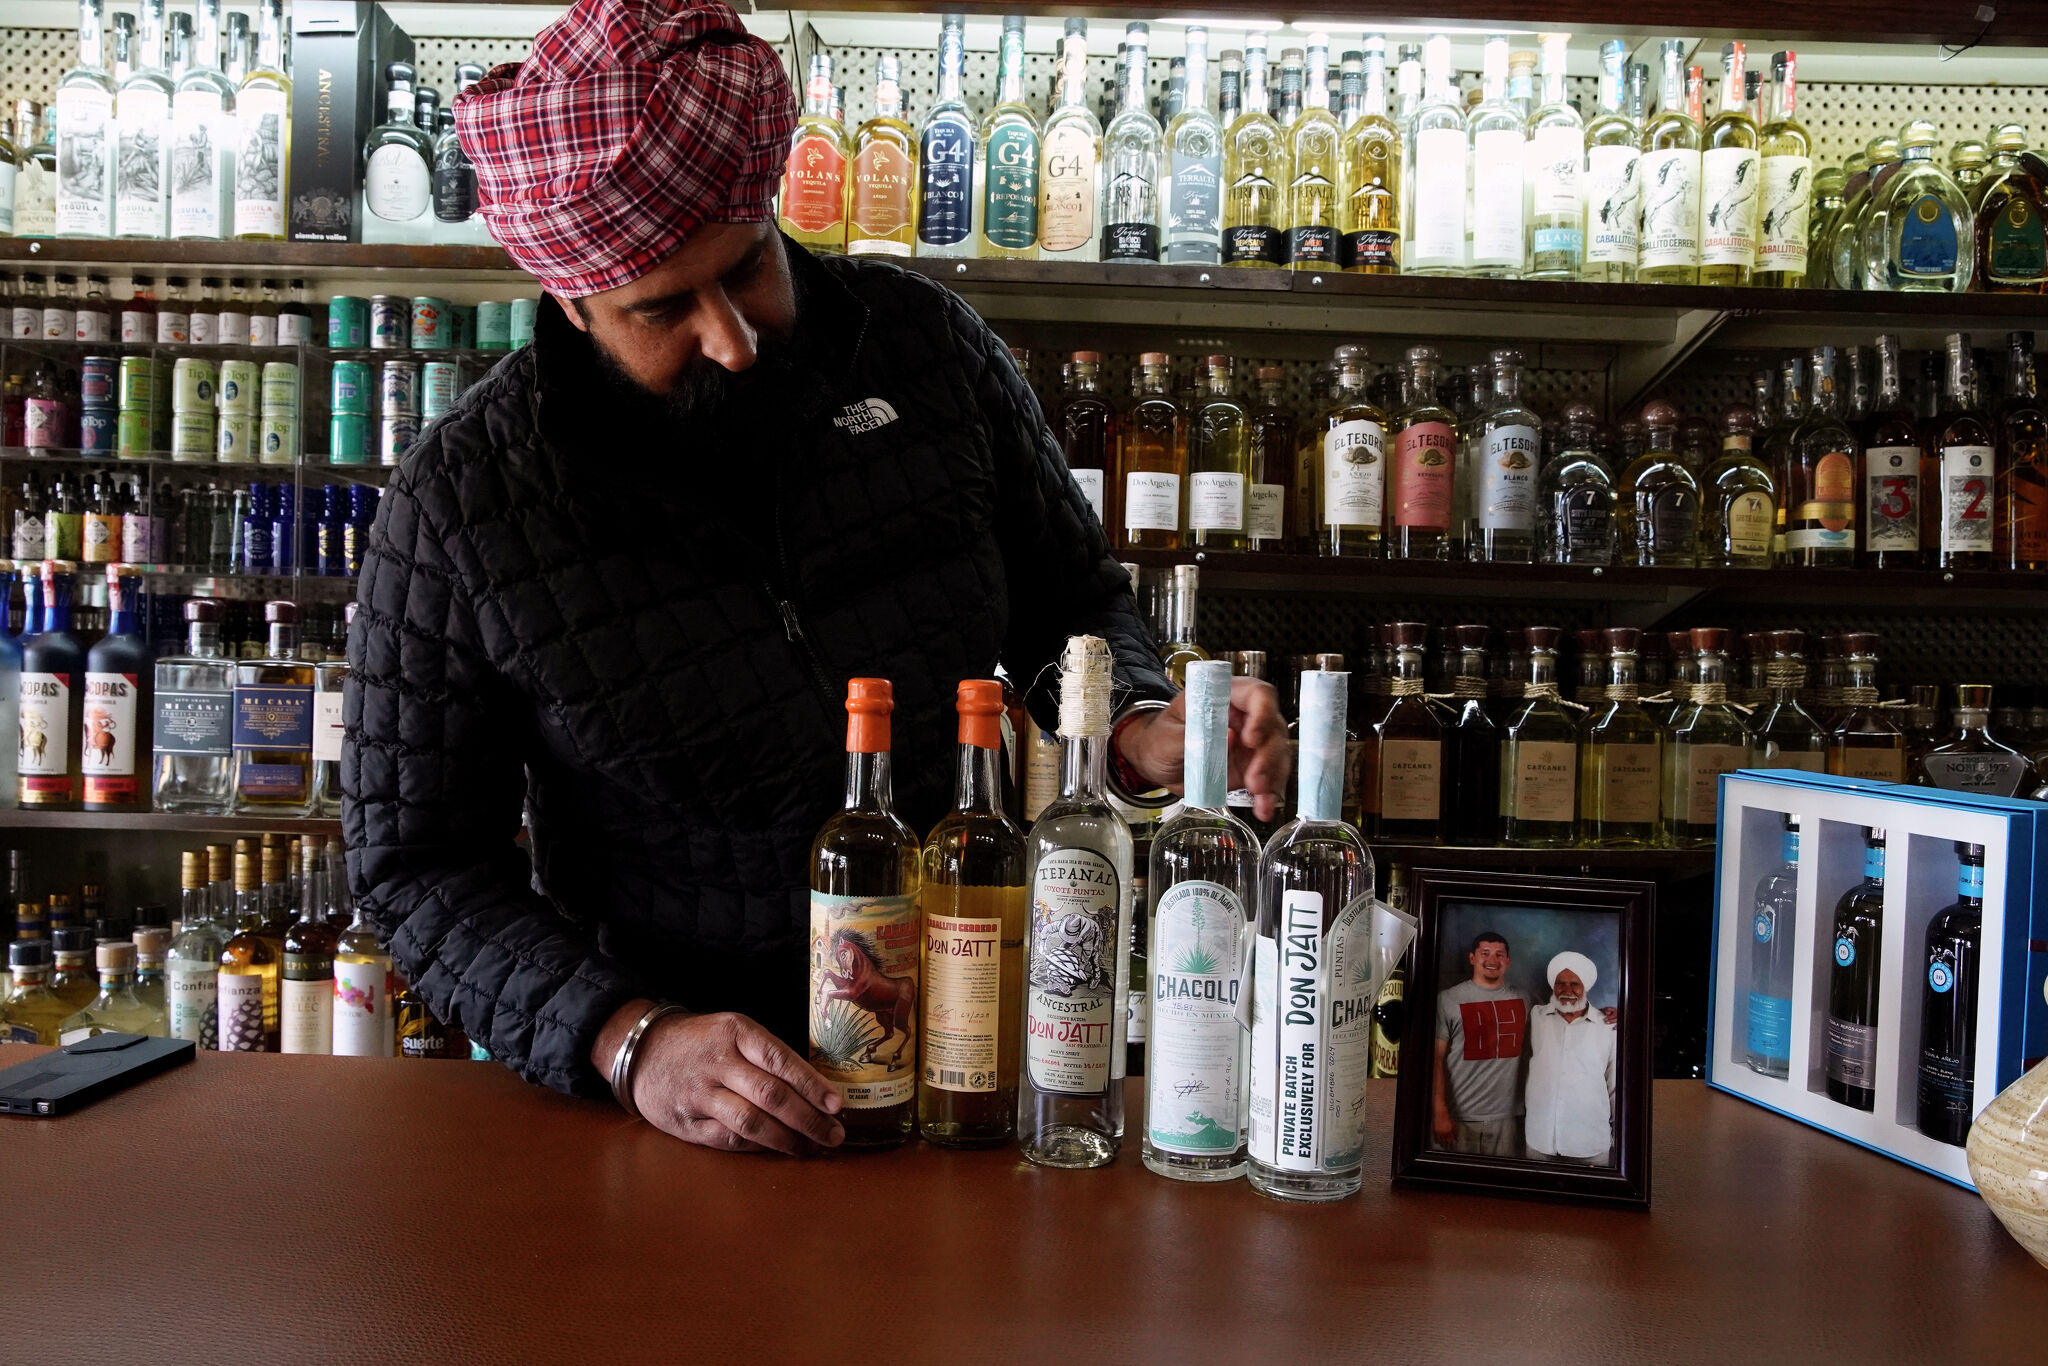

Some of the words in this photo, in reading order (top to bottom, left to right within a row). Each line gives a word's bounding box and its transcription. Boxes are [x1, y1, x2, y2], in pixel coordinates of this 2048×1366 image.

[928, 139, 966, 164] G4
[998, 142, 1035, 168] G4
[1047, 154, 1083, 178] G4
[790, 170, 841, 183] VOLANS
[856, 175, 908, 185] VOLANS
[1178, 174, 1216, 186] TERRALTA
[927, 190, 960, 199] BLANCO
[995, 191, 1033, 203] REPOSADO
[1046, 201, 1078, 211] BLANCO
[1233, 229, 1267, 243] Tequila
[1296, 229, 1331, 243] Tequila
[1356, 233, 1392, 248] Tequila
[1595, 233, 1631, 245] CABALLITO
[1669, 237, 1697, 249] CERRERO
[1704, 236, 1742, 248] CABALLITO
[1758, 244, 1796, 256] CABALLITO
[842, 400, 867, 416] THE
[832, 409, 873, 428] NORTH
[848, 418, 879, 436] FACE
[1346, 433, 1383, 453] TESORO
[1075, 475, 1097, 485] ngeles
[1132, 478, 1147, 487] Dos
[1195, 478, 1209, 487] Dos
[1503, 474, 1529, 482] BLANCO
[1586, 490, 1596, 505] 7
[1673, 492, 1685, 507] 7
[1752, 496, 1760, 510] 7
[1881, 479, 1910, 518] 3
[1960, 479, 1987, 519] 2
[267, 698, 300, 706] CASA
[1392, 762, 1433, 770] CAZCANES
[1527, 764, 1567, 772] CAZCANES
[1039, 867, 1113, 887] TEPANAL
[1044, 884, 1072, 895] COYOTE
[1073, 888, 1106, 897] PUNTAS
[1164, 887, 1190, 911] DESTILADO
[1191, 887, 1210, 897] 100%
[1210, 890, 1218, 900] DE
[1218, 893, 1235, 914] AGAVE
[958, 923, 998, 933] CERRERO
[1285, 902, 1318, 973] JATT
[927, 934, 948, 955] DON
[951, 938, 997, 957] JATT
[1335, 936, 1344, 977] PUNTAS
[220, 985, 261, 997] fianza
[1156, 974, 1240, 1007] CHACOLO
[1036, 993, 1104, 1013] ANCESTRAL
[1285, 976, 1316, 1028] DON
[175, 1003, 183, 1041] LANCO
[1186, 1011, 1199, 1019] EN
[1201, 1011, 1234, 1020] MEXIC
[1028, 1015, 1054, 1040] DON
[1057, 1021, 1109, 1044] JATT
[1840, 1023, 1867, 1035] REPOSADO
[403, 1035, 446, 1050] suerte
[1302, 1043, 1315, 1077] FOR
[1941, 1055, 1960, 1065] AÑEJO
[1285, 1055, 1297, 1098] BATCH
[1298, 1079, 1314, 1159] EXCLUSIVELY
[1282, 1099, 1297, 1156] PRIVATE
